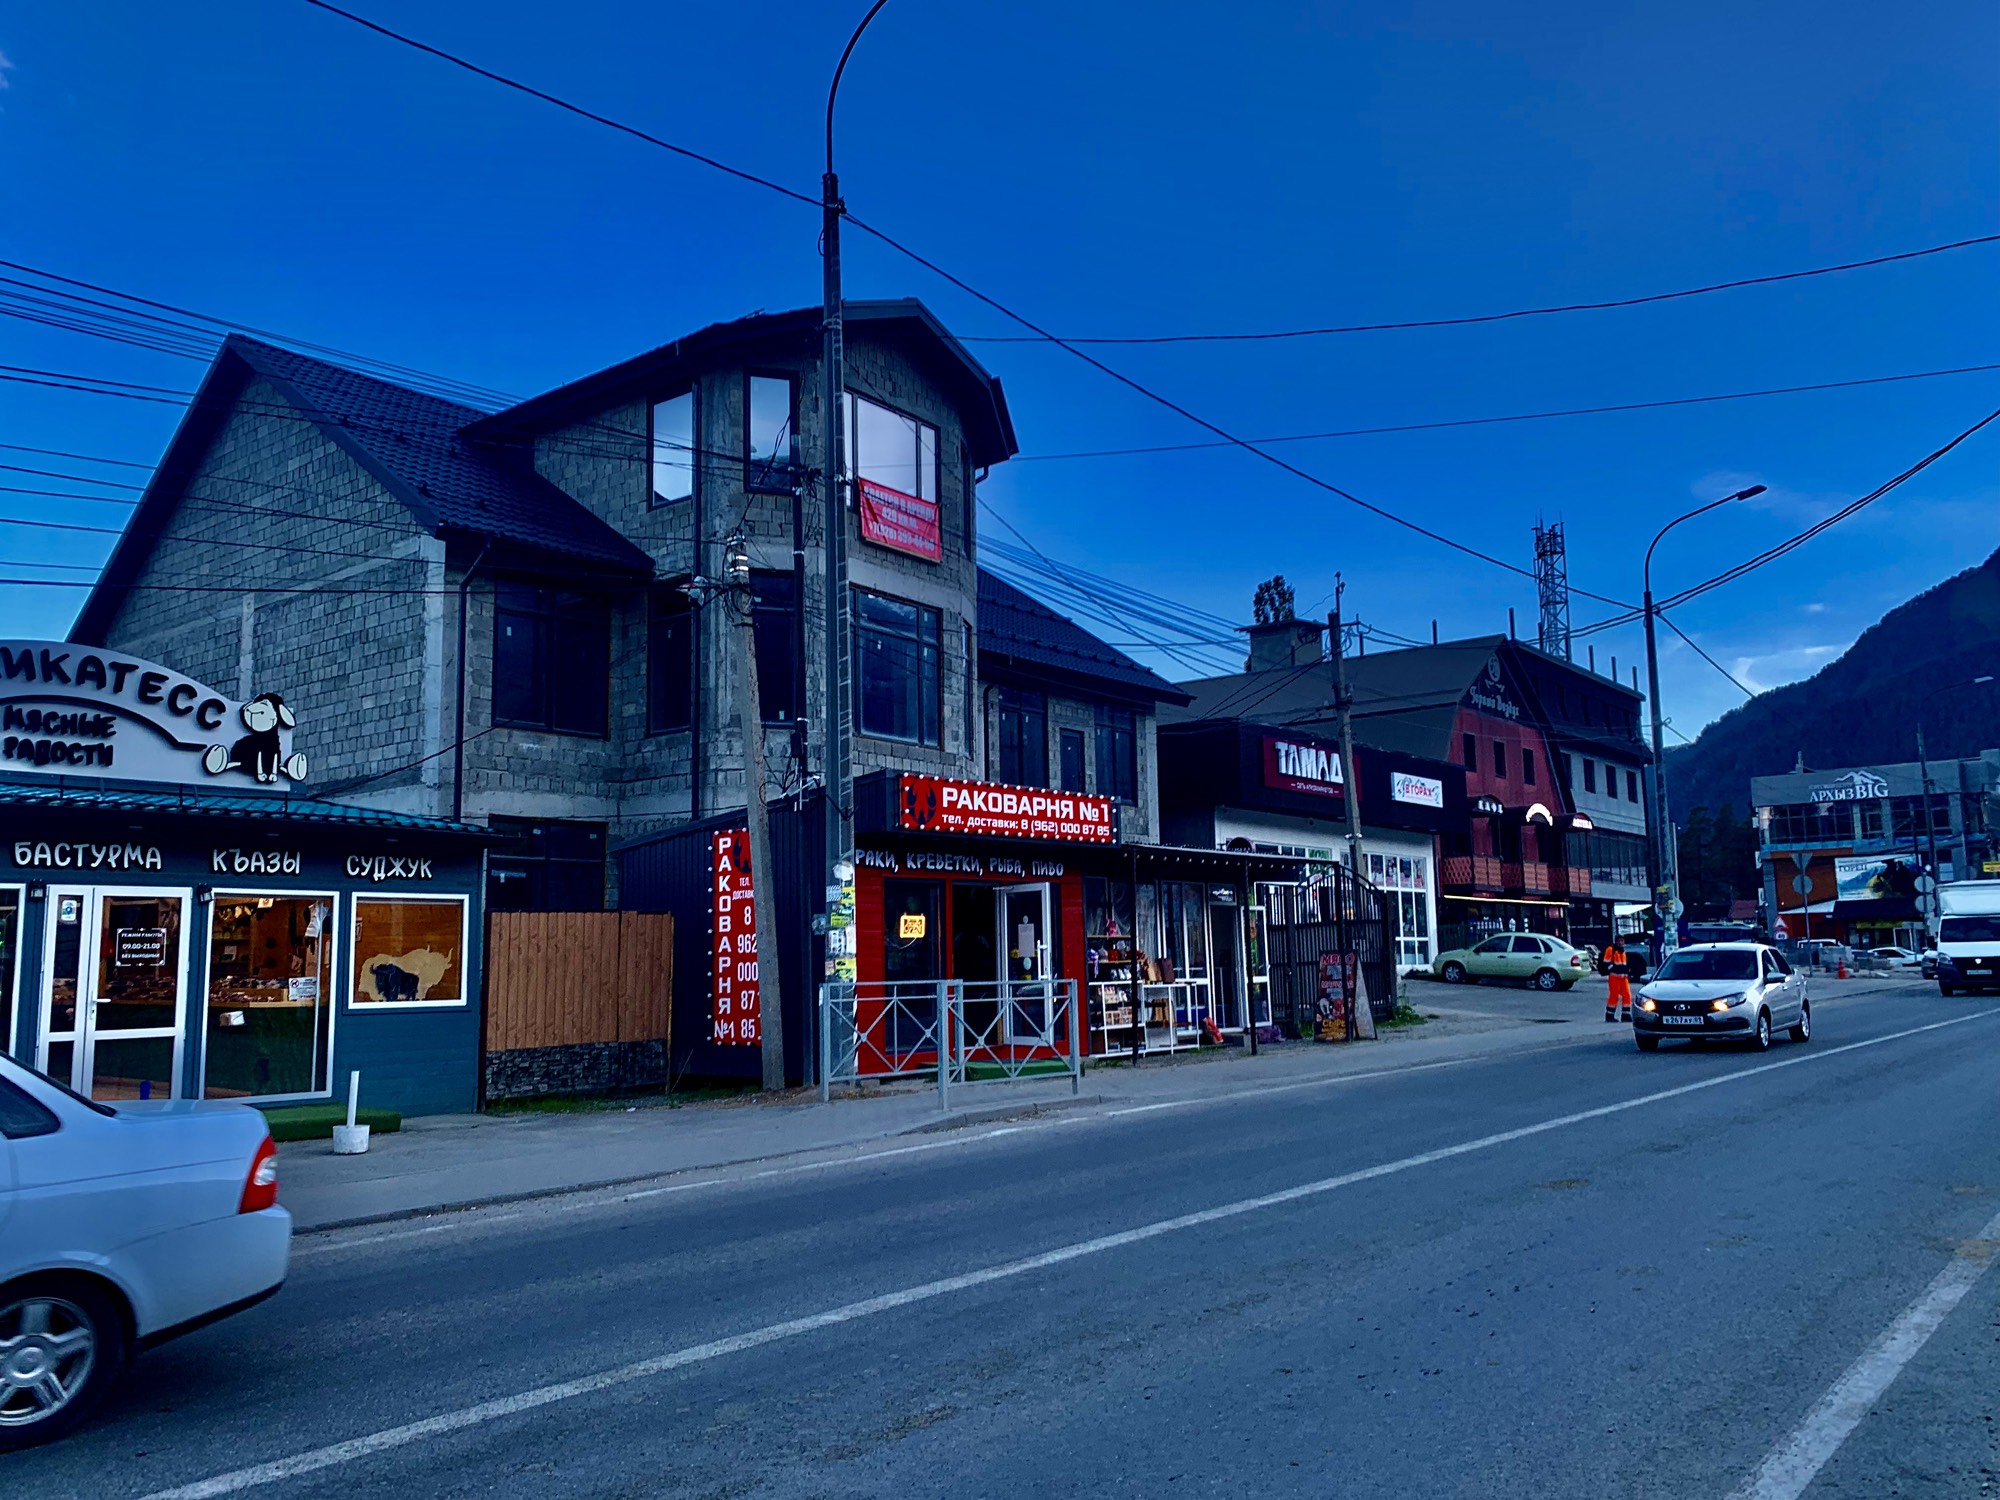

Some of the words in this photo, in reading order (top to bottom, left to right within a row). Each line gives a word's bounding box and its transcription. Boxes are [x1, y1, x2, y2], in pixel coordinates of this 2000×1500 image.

[0, 646, 227, 730] ИКАТЕСС
[3, 704, 117, 738] МЯСНЫЕ
[3, 736, 114, 766] РАДОСТИ
[1274, 741, 1344, 785] ТАМАД
[942, 787, 1073, 820] РАКОВАРНЯ
[1810, 787, 1854, 802] АРХЫЗ
[1855, 783, 1889, 799] BIG
[942, 814, 964, 825] тел.
[967, 816, 1019, 829] доставки:
[1021, 819, 1029, 830] 8
[1031, 820, 1058, 834] (962)
[1061, 822, 1080, 834] 000
[1083, 823, 1095, 836] 87
[1097, 825, 1110, 836] 85
[15, 842, 162, 869] БАСТУРМА
[213, 849, 300, 874] КЪАЗЫ
[346, 855, 432, 881] СУДЖУК
[855, 849, 898, 873] РАКИ,
[906, 852, 983, 876] КРЕВЕТКИ,
[990, 857, 1025, 877] РЫБА,
[1032, 860, 1064, 876] ПИВО
[732, 890, 754, 900] ДОСТАВК
[718, 836, 732, 1015] РАКОВАРНЯ
[744, 906, 752, 925] 8
[737, 933, 757, 953] 962
[737, 962, 758, 981] 000
[741, 990, 755, 1010] 87
[714, 1018, 735, 1040] №1
[741, 1018, 755, 1038] 85
